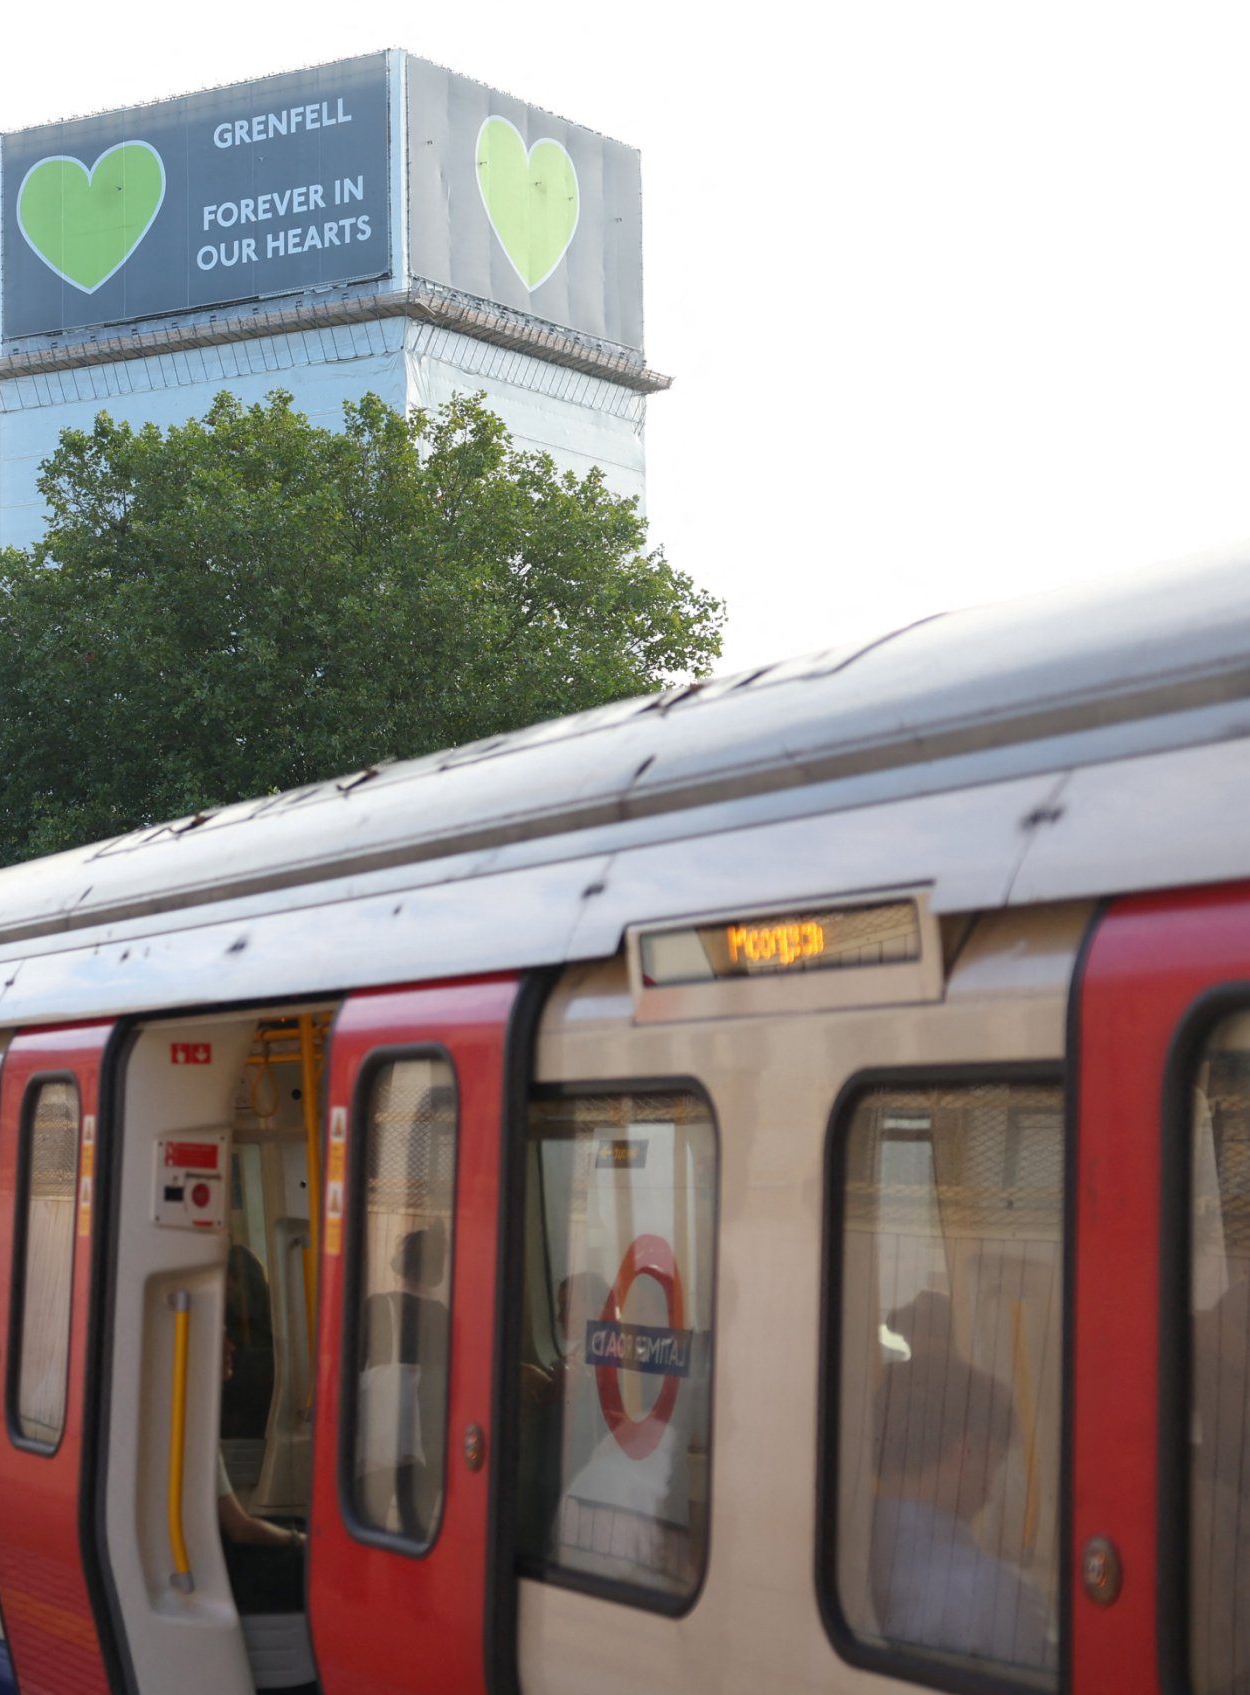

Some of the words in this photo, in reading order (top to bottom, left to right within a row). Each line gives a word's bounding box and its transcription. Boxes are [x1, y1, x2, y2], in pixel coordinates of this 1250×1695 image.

[213, 98, 352, 149] GRENFELL
[203, 184, 326, 231] FOREVER
[334, 175, 364, 205] IN
[196, 238, 258, 271] OUR
[266, 215, 372, 258] HEARTS
